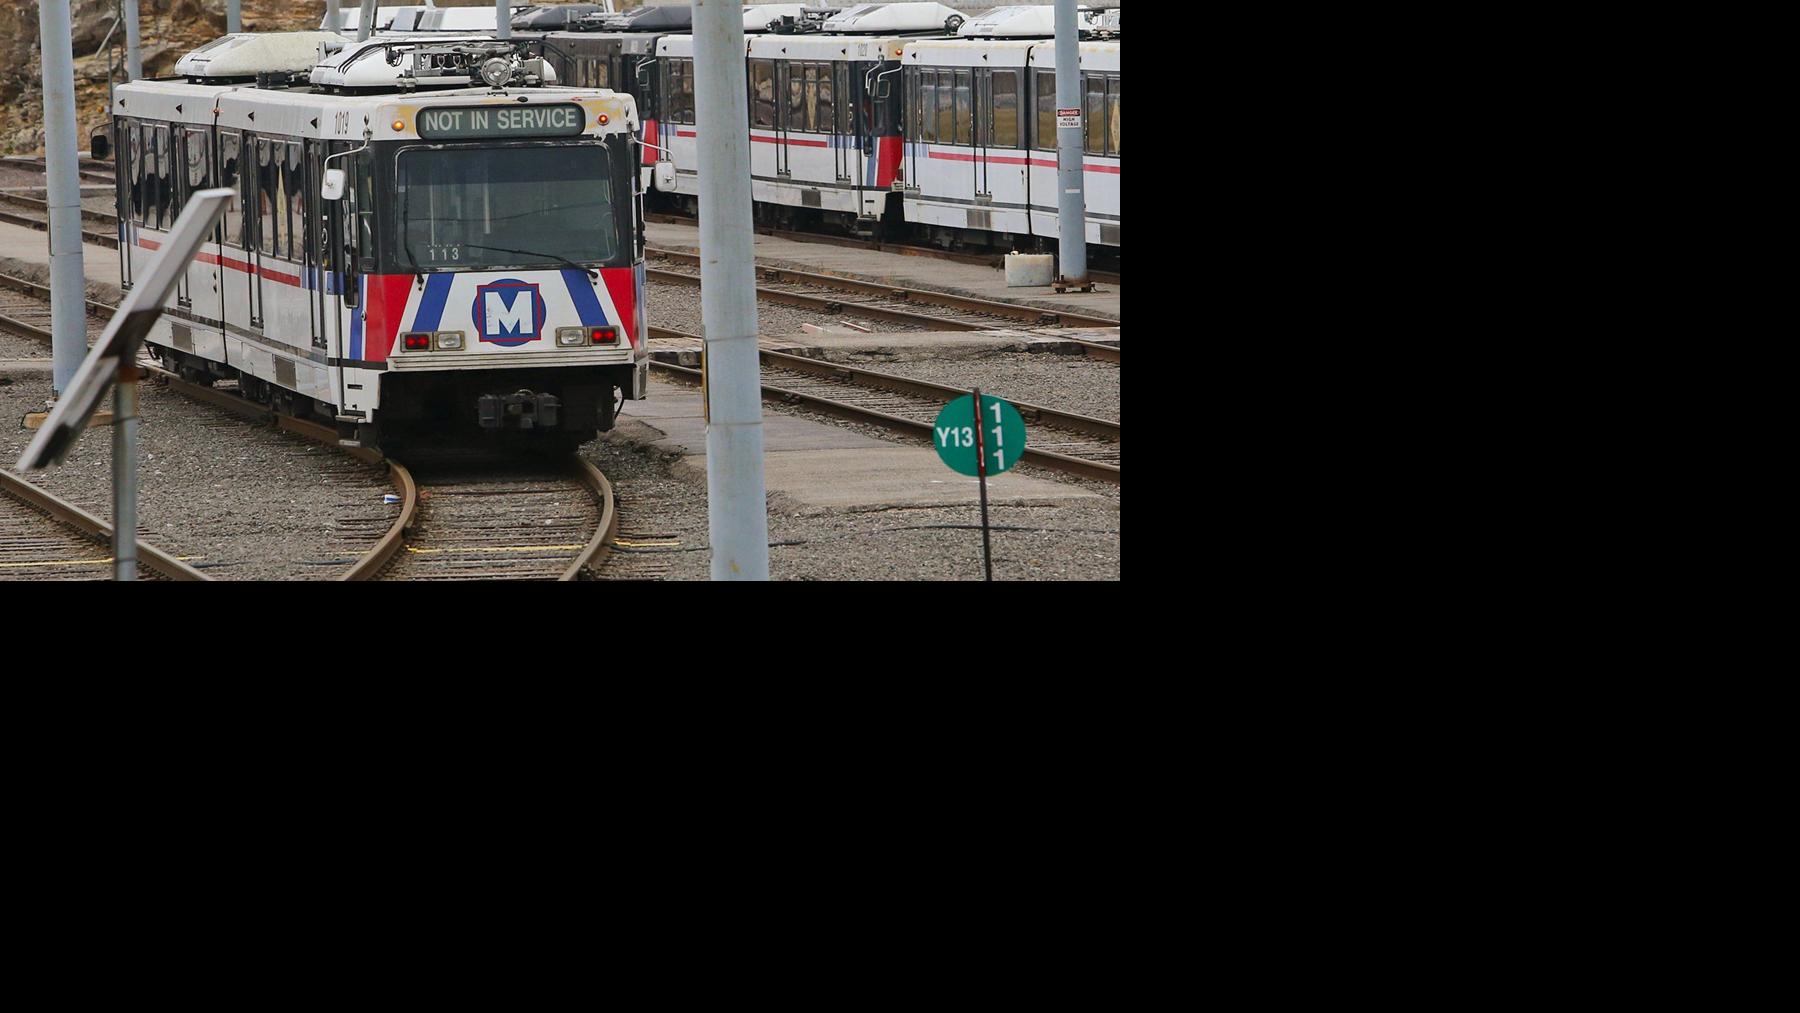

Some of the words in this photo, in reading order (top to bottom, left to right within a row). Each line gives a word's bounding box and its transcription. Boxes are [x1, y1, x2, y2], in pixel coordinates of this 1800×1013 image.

[335, 111, 350, 135] 1019
[425, 111, 463, 131] NOT
[471, 110, 488, 130] IN
[497, 108, 577, 130] SERVICE
[485, 291, 533, 335] M
[936, 427, 974, 447] Y13
